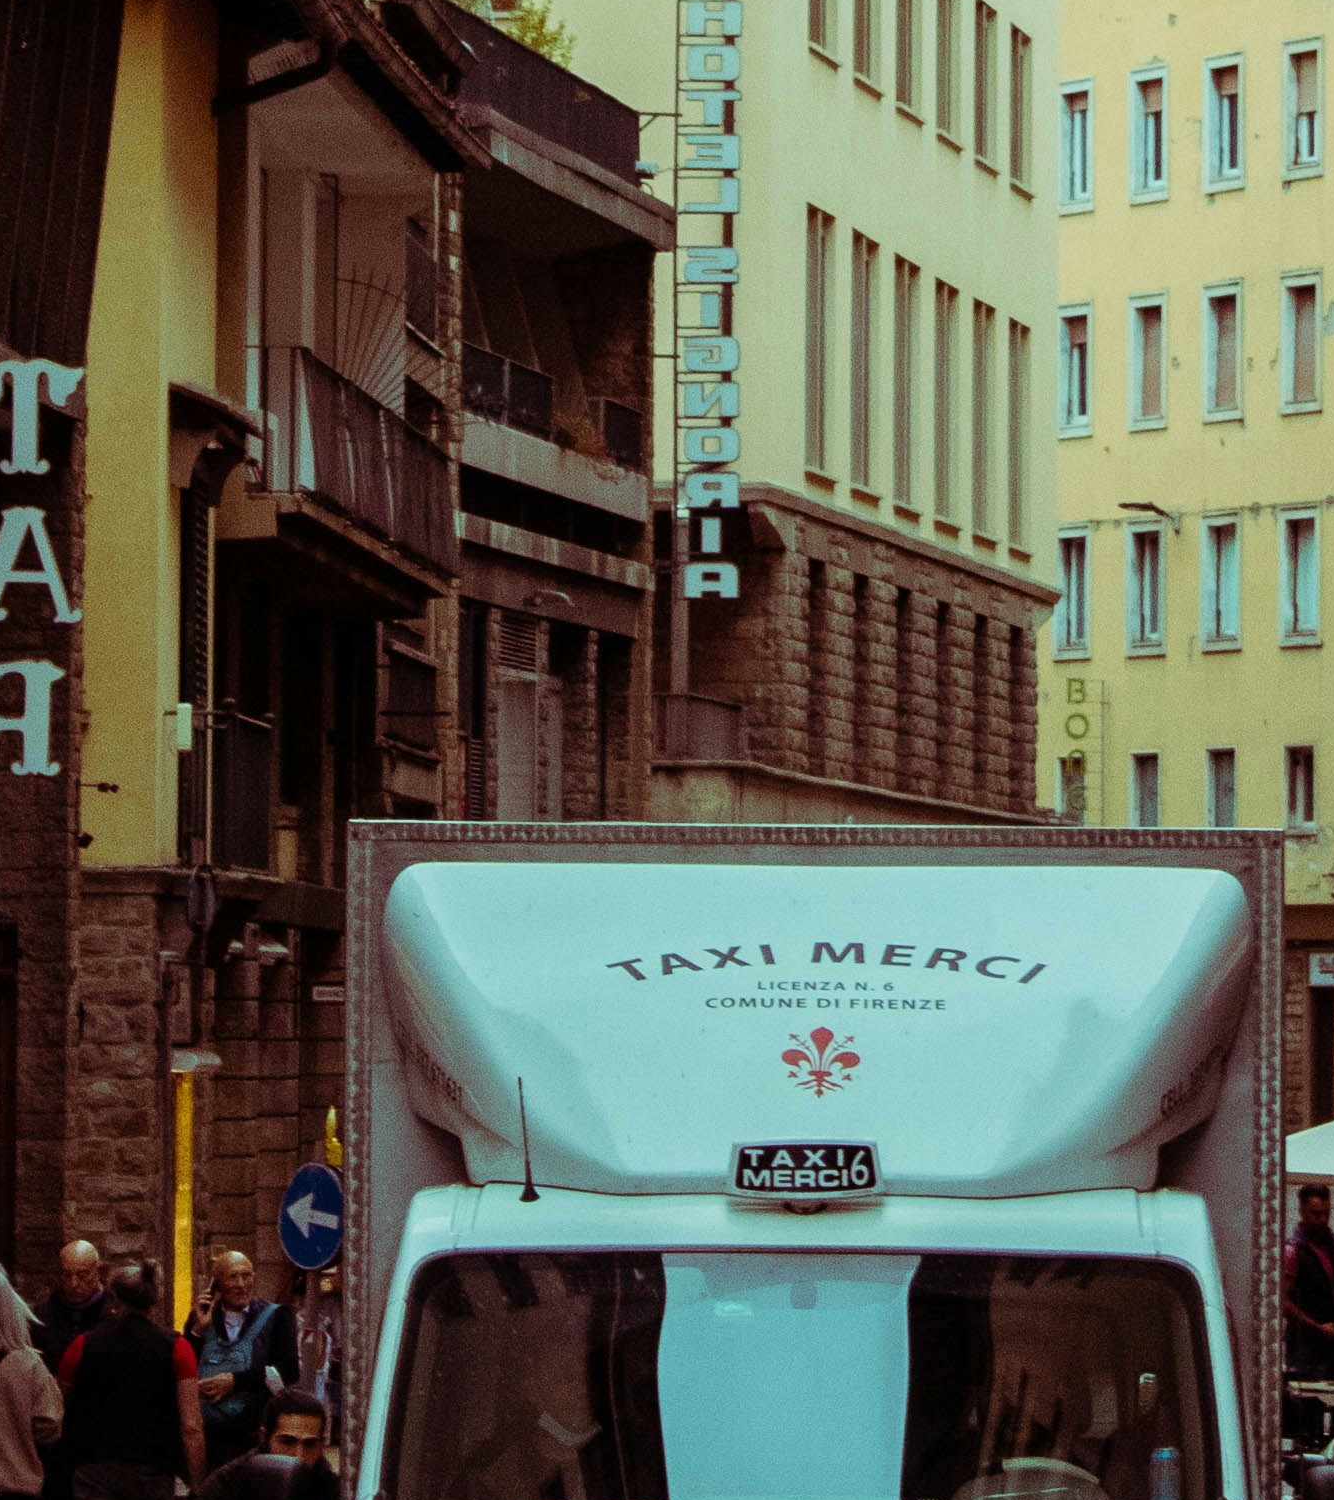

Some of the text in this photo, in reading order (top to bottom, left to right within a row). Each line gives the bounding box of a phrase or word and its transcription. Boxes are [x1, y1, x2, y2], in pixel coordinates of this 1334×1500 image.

[605, 941, 1050, 985] TAXI MERCI
[756, 980, 895, 993] LICENZA N. 6
[704, 997, 947, 1011] COMUNE DI FIRENZE
[743, 1148, 870, 1187] TAXI 6
[741, 1168, 849, 1188] MERCI
